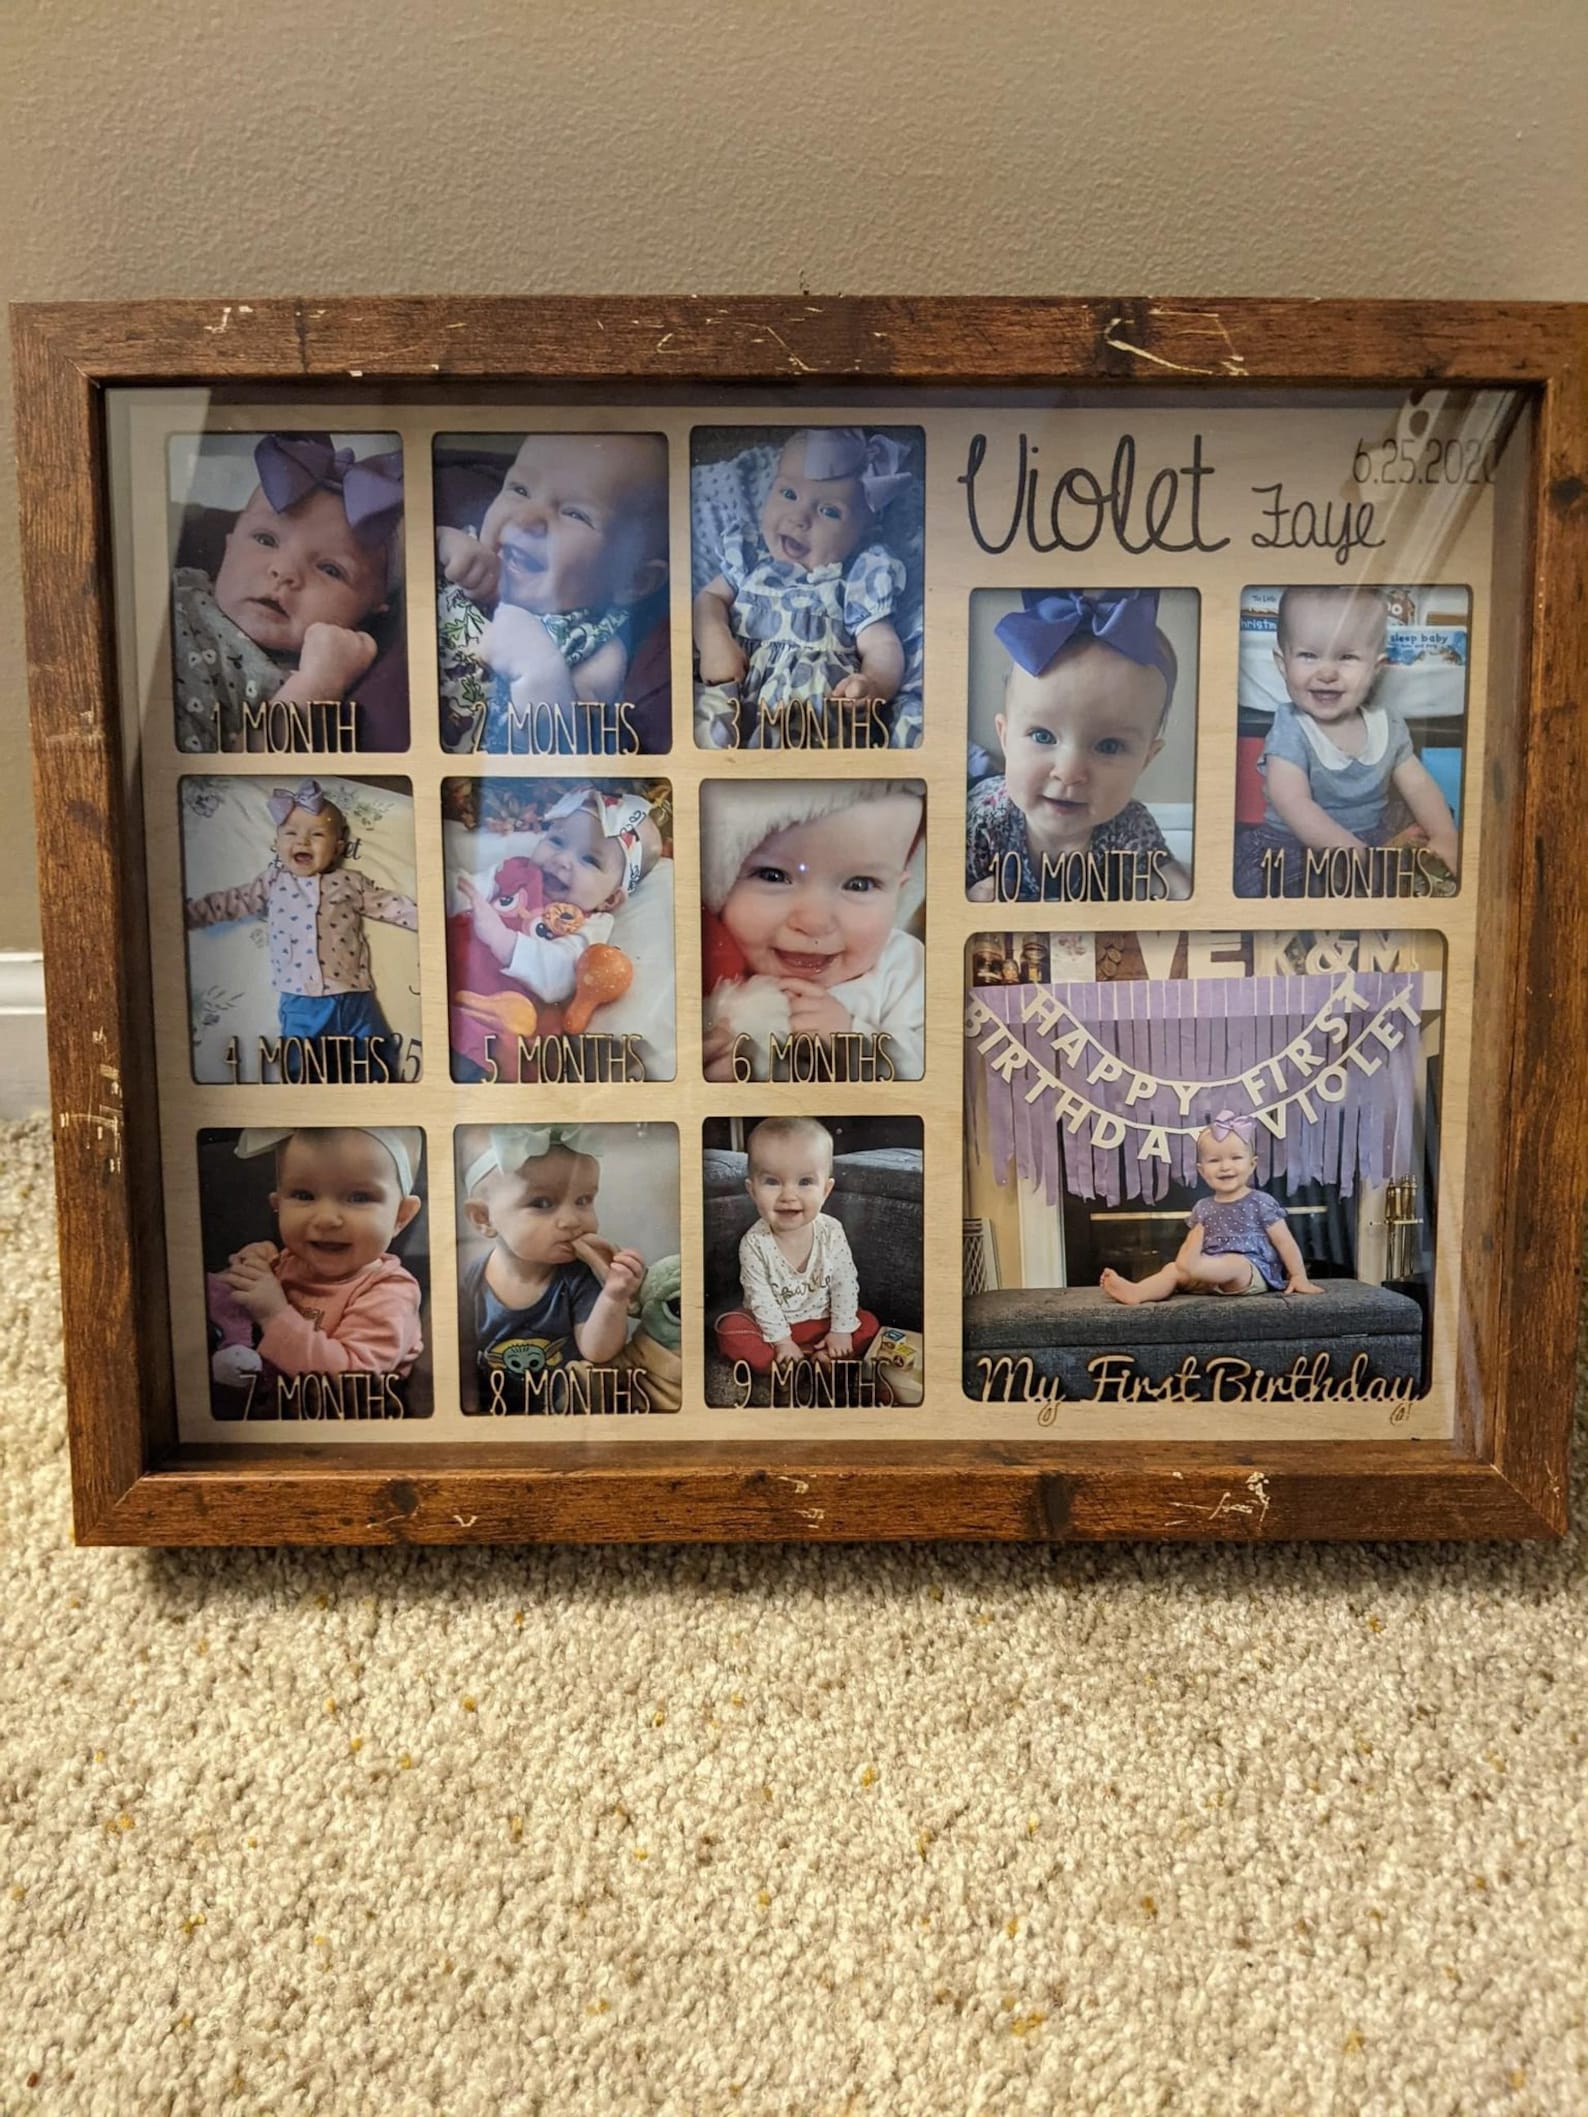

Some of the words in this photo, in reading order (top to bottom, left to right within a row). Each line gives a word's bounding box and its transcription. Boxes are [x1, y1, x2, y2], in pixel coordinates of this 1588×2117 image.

[956, 433, 1231, 555] Violet
[1250, 482, 1386, 565] Faye
[1421, 631, 1449, 645] baby
[210, 700, 224, 753] 1
[242, 700, 357, 753] MONTH
[470, 700, 488, 754] 2
[507, 701, 640, 754] MONTHS
[727, 697, 741, 750] 3
[760, 697, 890, 750] MONTHS
[987, 850, 1023, 901] 10
[1039, 849, 1171, 901] MONTHS
[1259, 847, 1286, 898] 11
[1303, 846, 1433, 898] MONTHS
[224, 1035, 239, 1085] 4
[258, 1035, 390, 1085] MONTHS
[480, 1035, 499, 1084] 5
[517, 1034, 647, 1084] MONTHS
[731, 1032, 751, 1083] 6
[769, 1032, 896, 1083] MONTHS
[1021, 986, 1202, 1116] HAPPY
[1240, 971, 1370, 1107] FIRST
[1254, 985, 1423, 1140] VIOLET
[239, 1373, 257, 1421] 7
[277, 1373, 405, 1421] MONTHS
[489, 1369, 508, 1416] 8
[524, 1367, 651, 1415] MONTHS
[733, 1359, 752, 1409] 9
[770, 1359, 896, 1409] MONTHS
[976, 1354, 1067, 1427] My
[1084, 1353, 1202, 1402] First
[1205, 1351, 1420, 1425] Birthday
